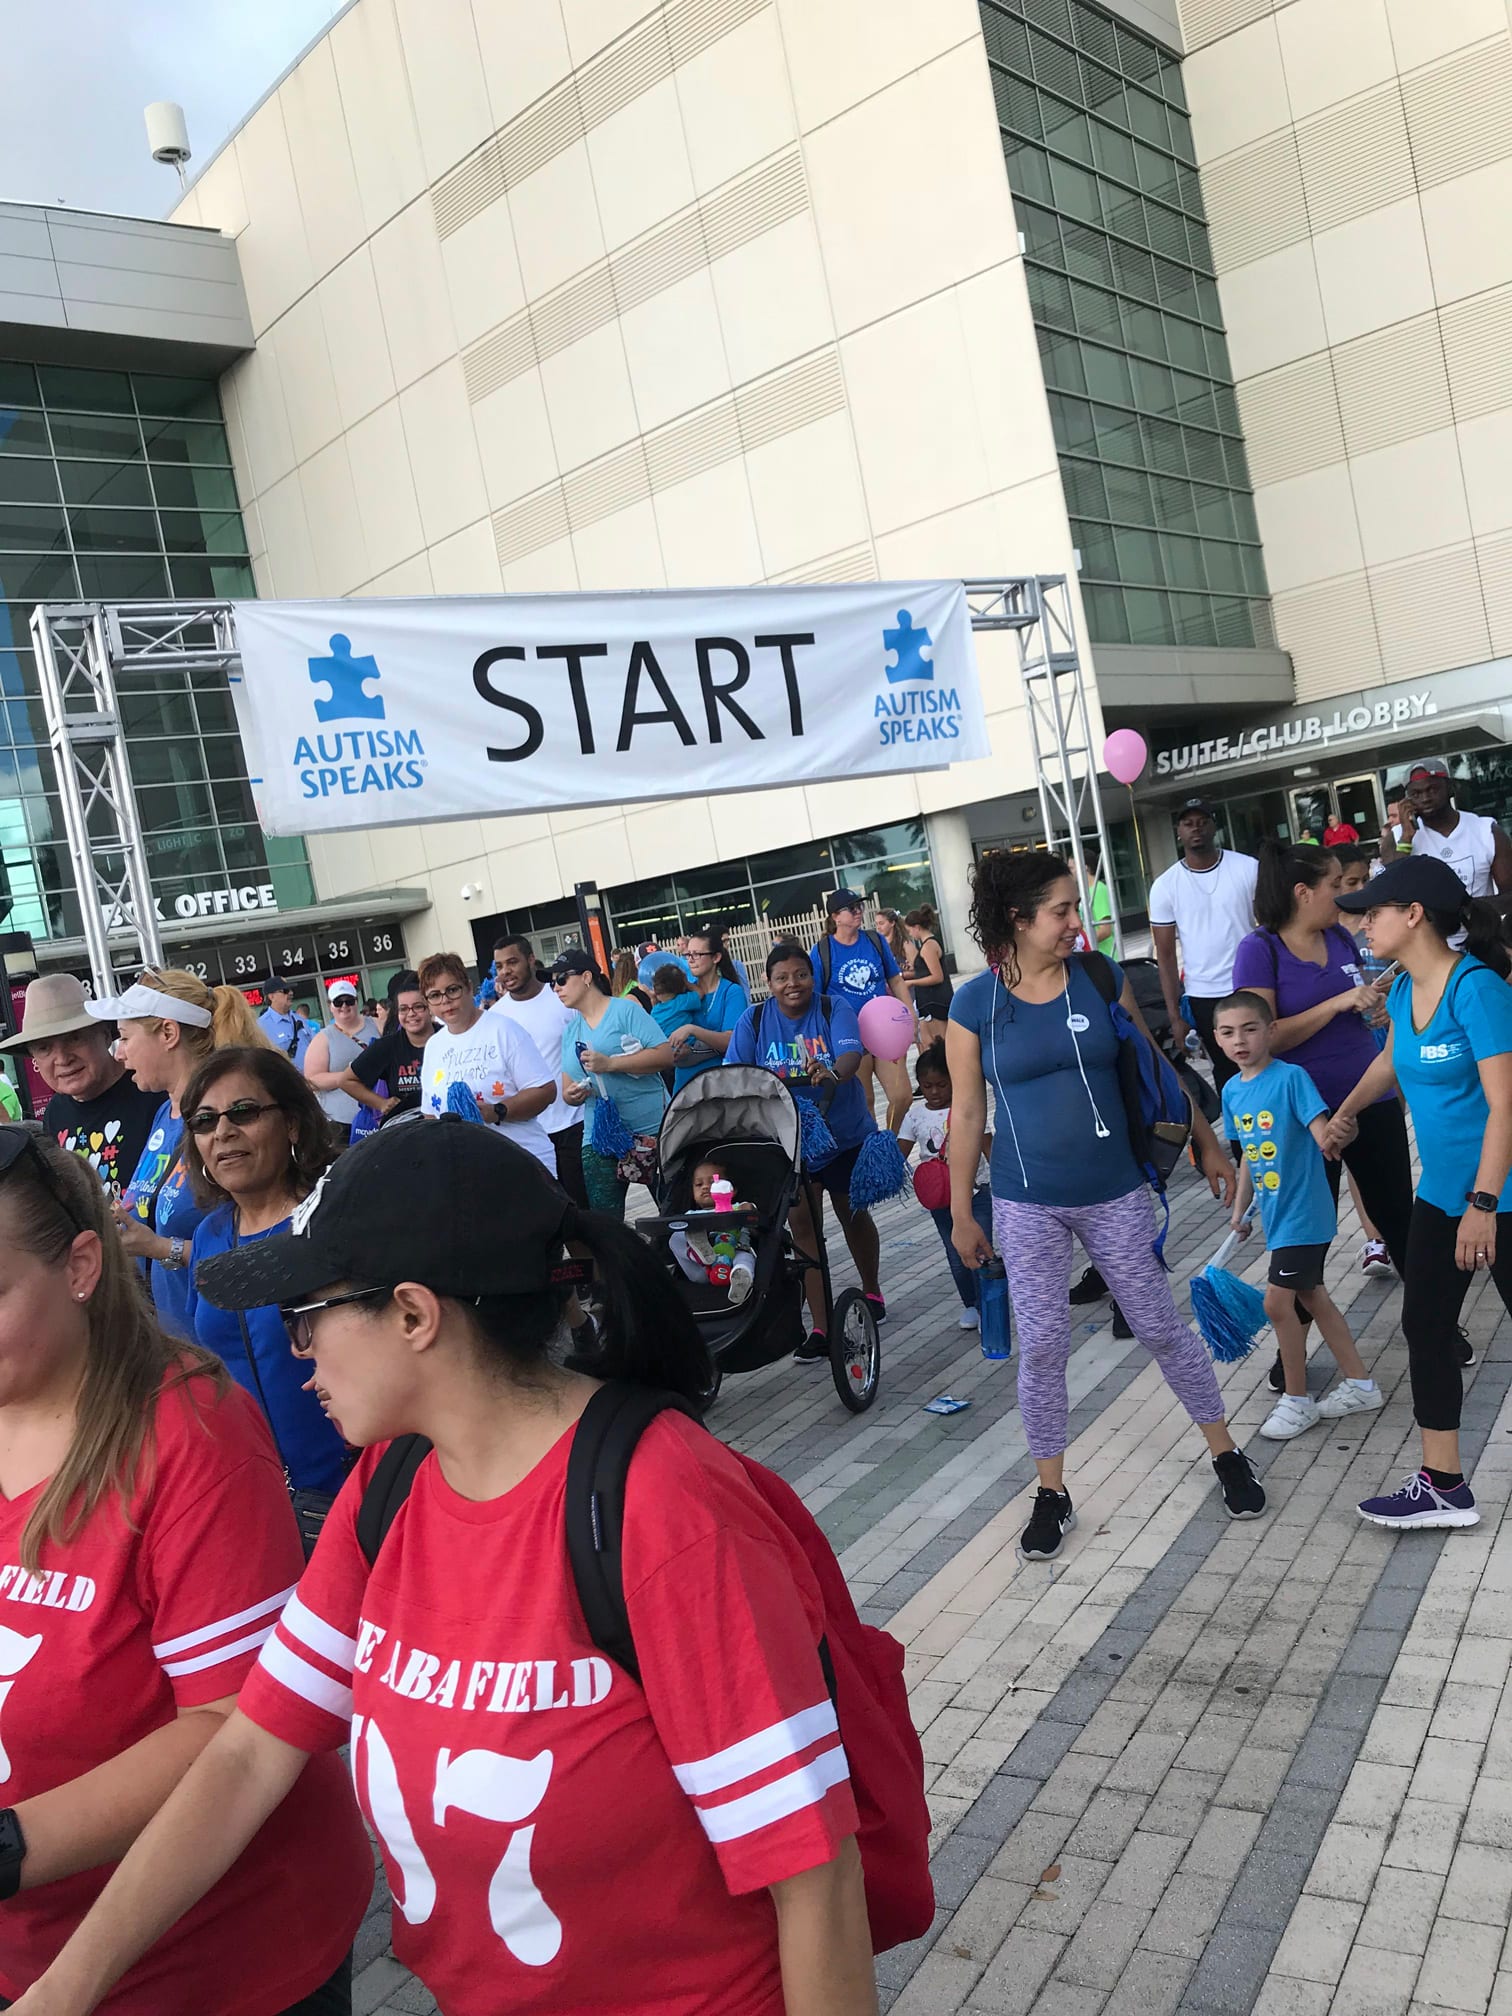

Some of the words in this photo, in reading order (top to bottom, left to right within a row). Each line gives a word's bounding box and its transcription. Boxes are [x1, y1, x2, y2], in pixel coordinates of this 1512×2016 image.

[473, 633, 815, 762] START
[874, 688, 961, 718] AUTISM
[879, 715, 961, 745] SPEAKS
[1156, 736, 1230, 774] SUITE
[1250, 716, 1322, 752] CLUB
[1333, 691, 1431, 734] LOBBY
[293, 729, 425, 765] AUTISM
[301, 760, 424, 799] SPEAKS
[174, 884, 278, 918] OFFICE
[282, 948, 305, 967] 34
[328, 941, 349, 959] 35
[373, 934, 393, 952] 36
[235, 955, 257, 974] 33
[766, 1034, 828, 1061] AUTSM
[379, 1639, 614, 1714] ABAFIELD
